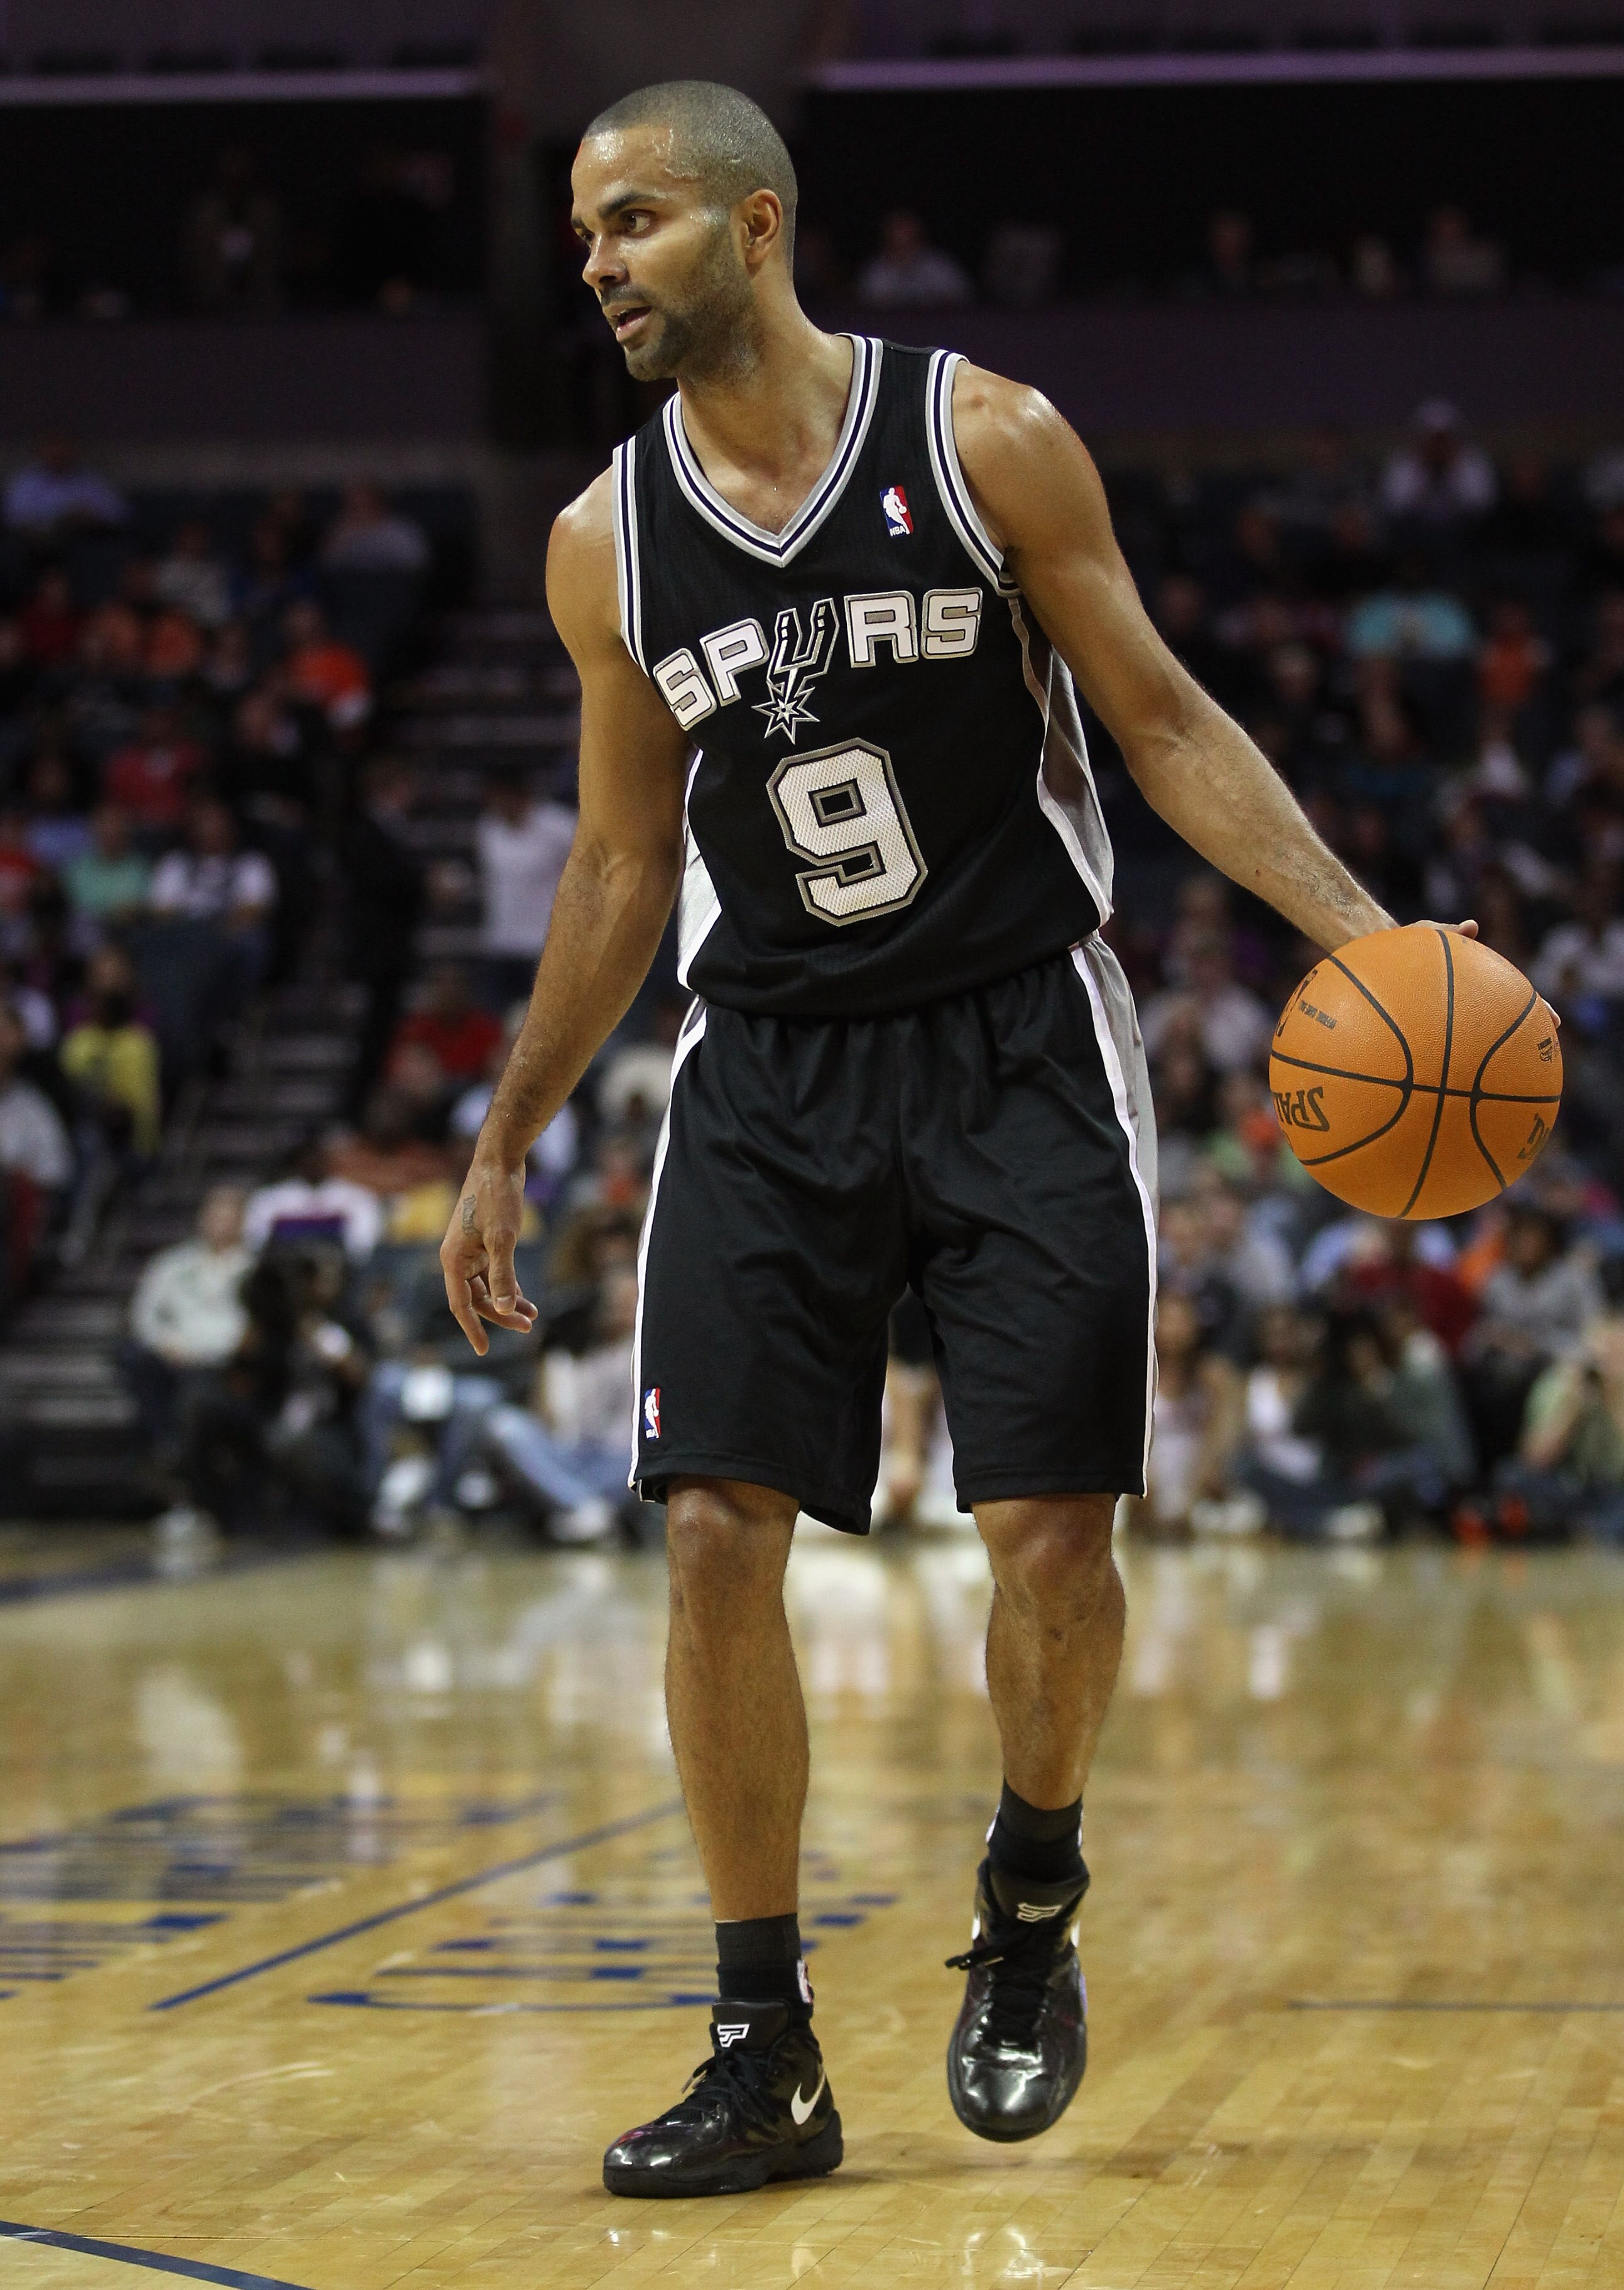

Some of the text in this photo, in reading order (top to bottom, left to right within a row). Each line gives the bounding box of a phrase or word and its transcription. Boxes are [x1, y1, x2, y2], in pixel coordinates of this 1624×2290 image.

[890, 525, 906, 537] NBA
[653, 587, 983, 738] SPURS
[766, 738, 929, 927] 9
